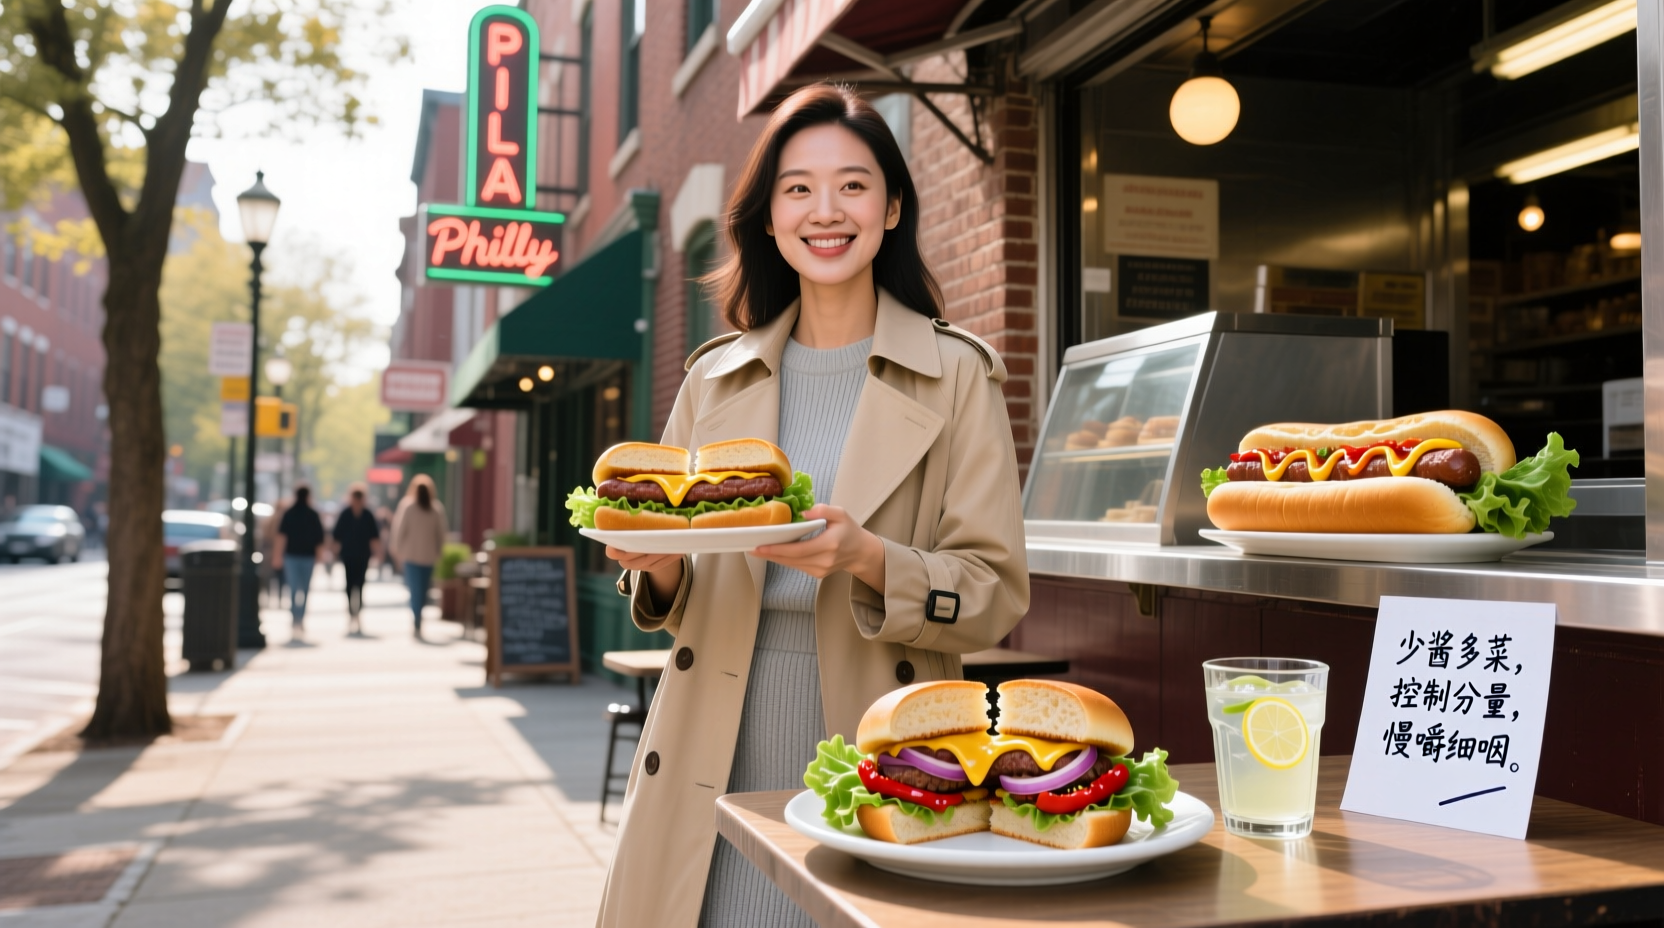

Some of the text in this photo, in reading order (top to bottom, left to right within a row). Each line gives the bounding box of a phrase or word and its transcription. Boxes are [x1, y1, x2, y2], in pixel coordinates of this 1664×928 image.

[480, 21, 523, 204] PILA
[427, 216, 559, 280] Philly
[1396, 629, 1523, 676] 少酱多菜，
[1389, 676, 1520, 723] 控制分量，
